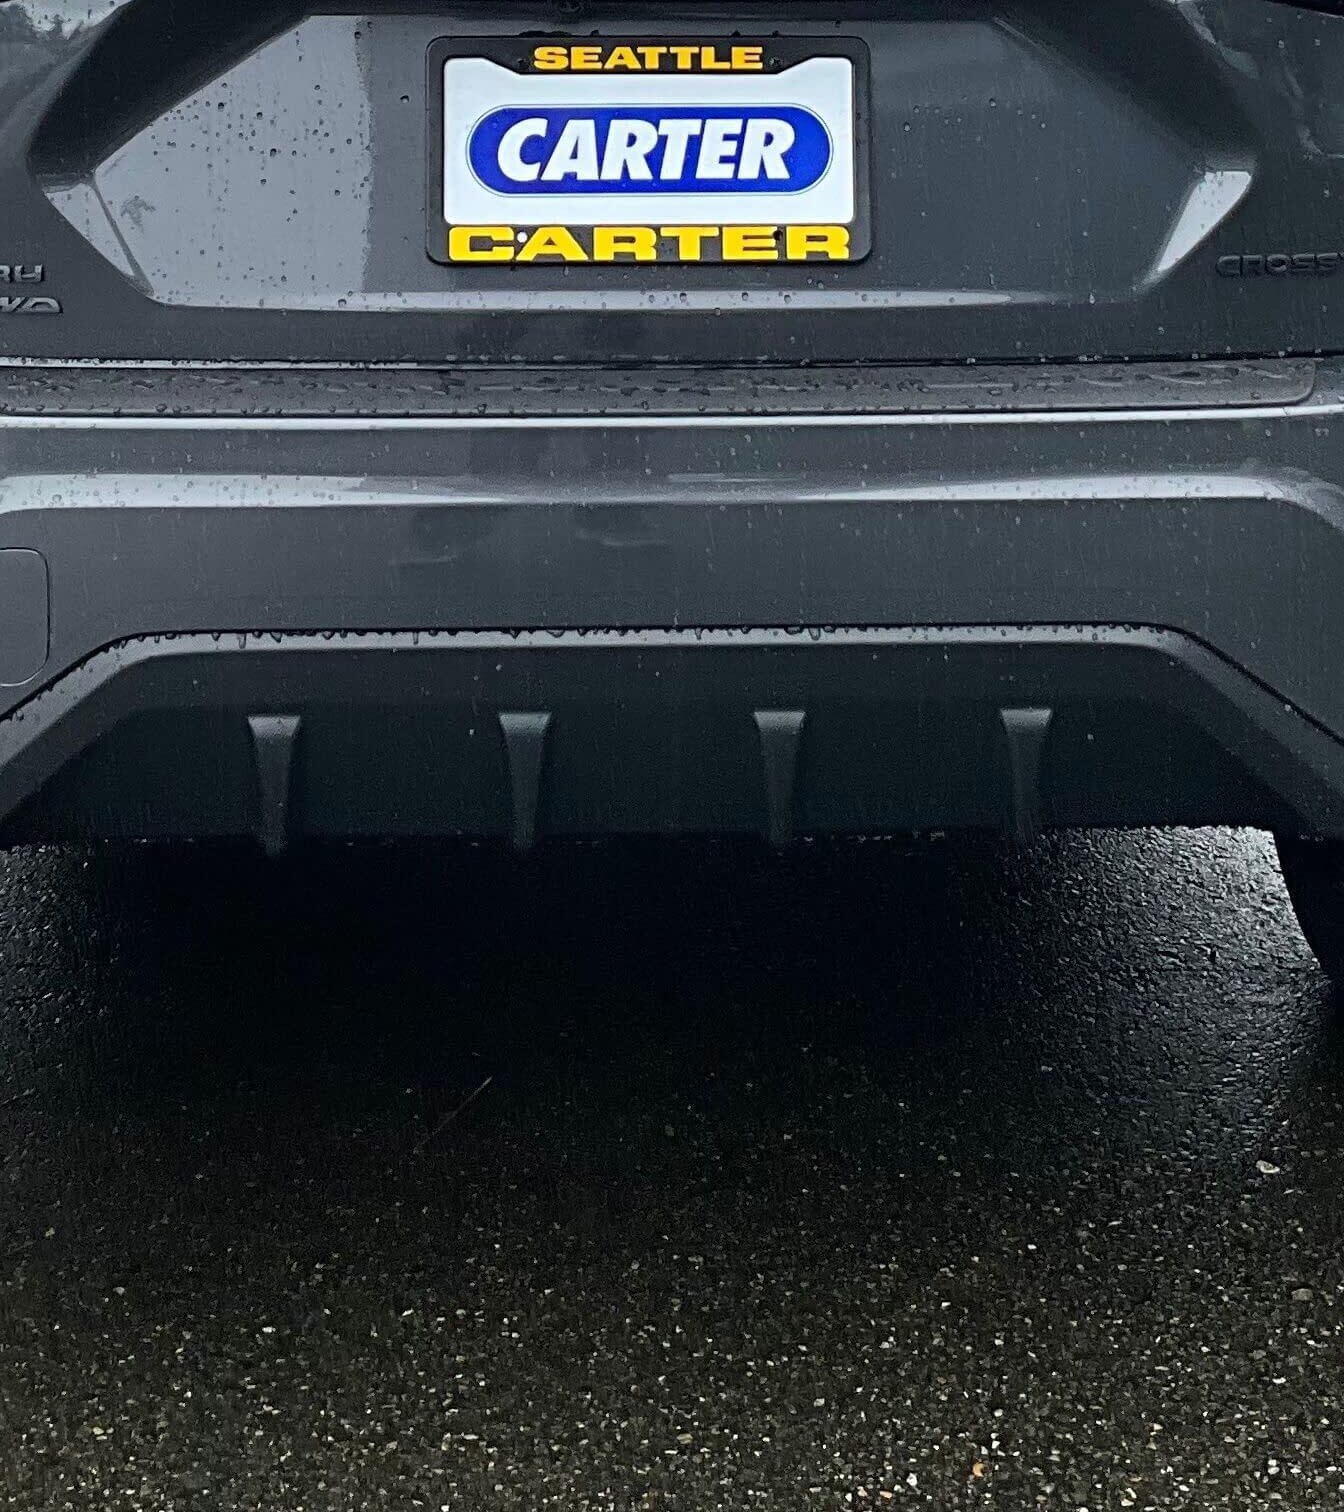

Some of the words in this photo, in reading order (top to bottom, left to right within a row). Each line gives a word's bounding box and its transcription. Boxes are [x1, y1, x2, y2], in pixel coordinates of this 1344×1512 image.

[533, 45, 764, 70] SEATTLE
[497, 117, 796, 182] CARTER
[448, 226, 850, 262] CARTER
